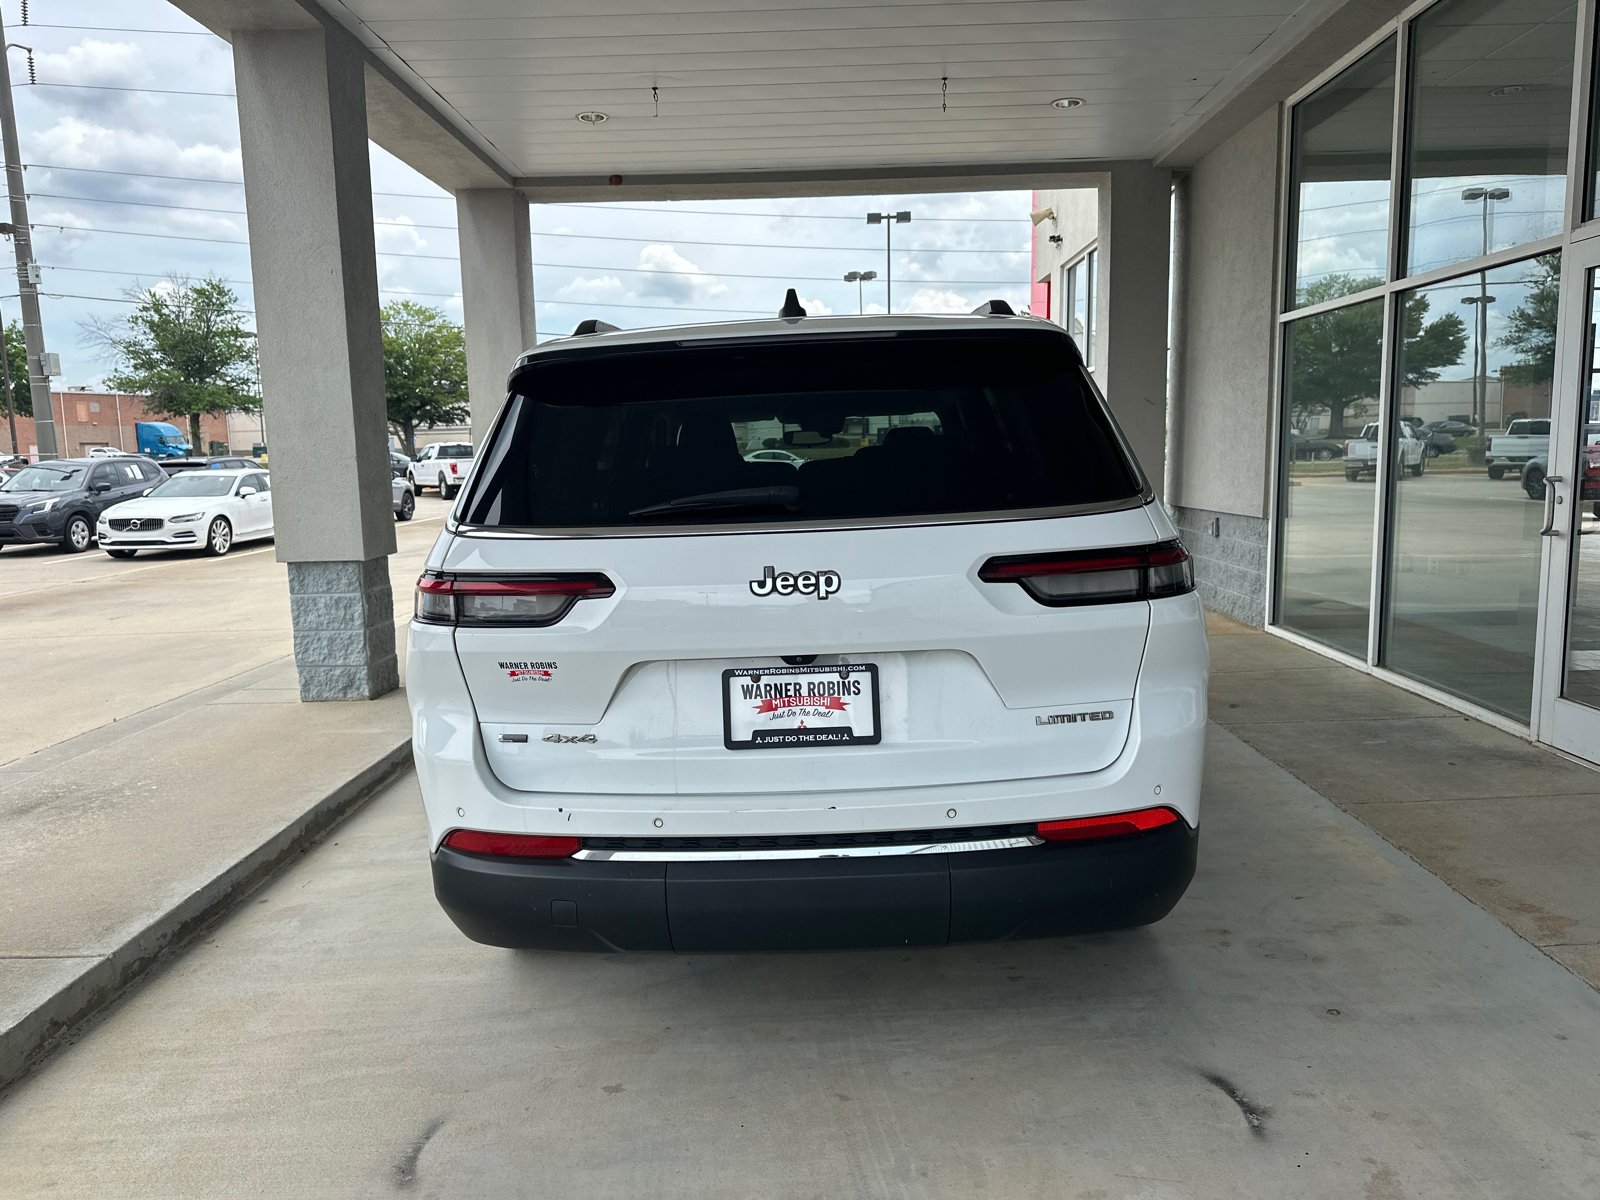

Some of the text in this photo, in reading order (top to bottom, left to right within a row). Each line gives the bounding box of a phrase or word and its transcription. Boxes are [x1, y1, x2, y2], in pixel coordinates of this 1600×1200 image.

[749, 566, 841, 600] Jeep
[498, 661, 558, 670] WARNER ROBINS
[741, 680, 861, 700] WARNER ROBINS
[772, 697, 830, 708] MITSUBISHI
[769, 708, 834, 721] Just Do The Deal!
[1035, 710, 1114, 726] LIMITED
[541, 734, 598, 744] 4x4
[763, 735, 784, 744] JUST
[799, 734, 815, 742] THE
[816, 733, 841, 741] DEAL!
